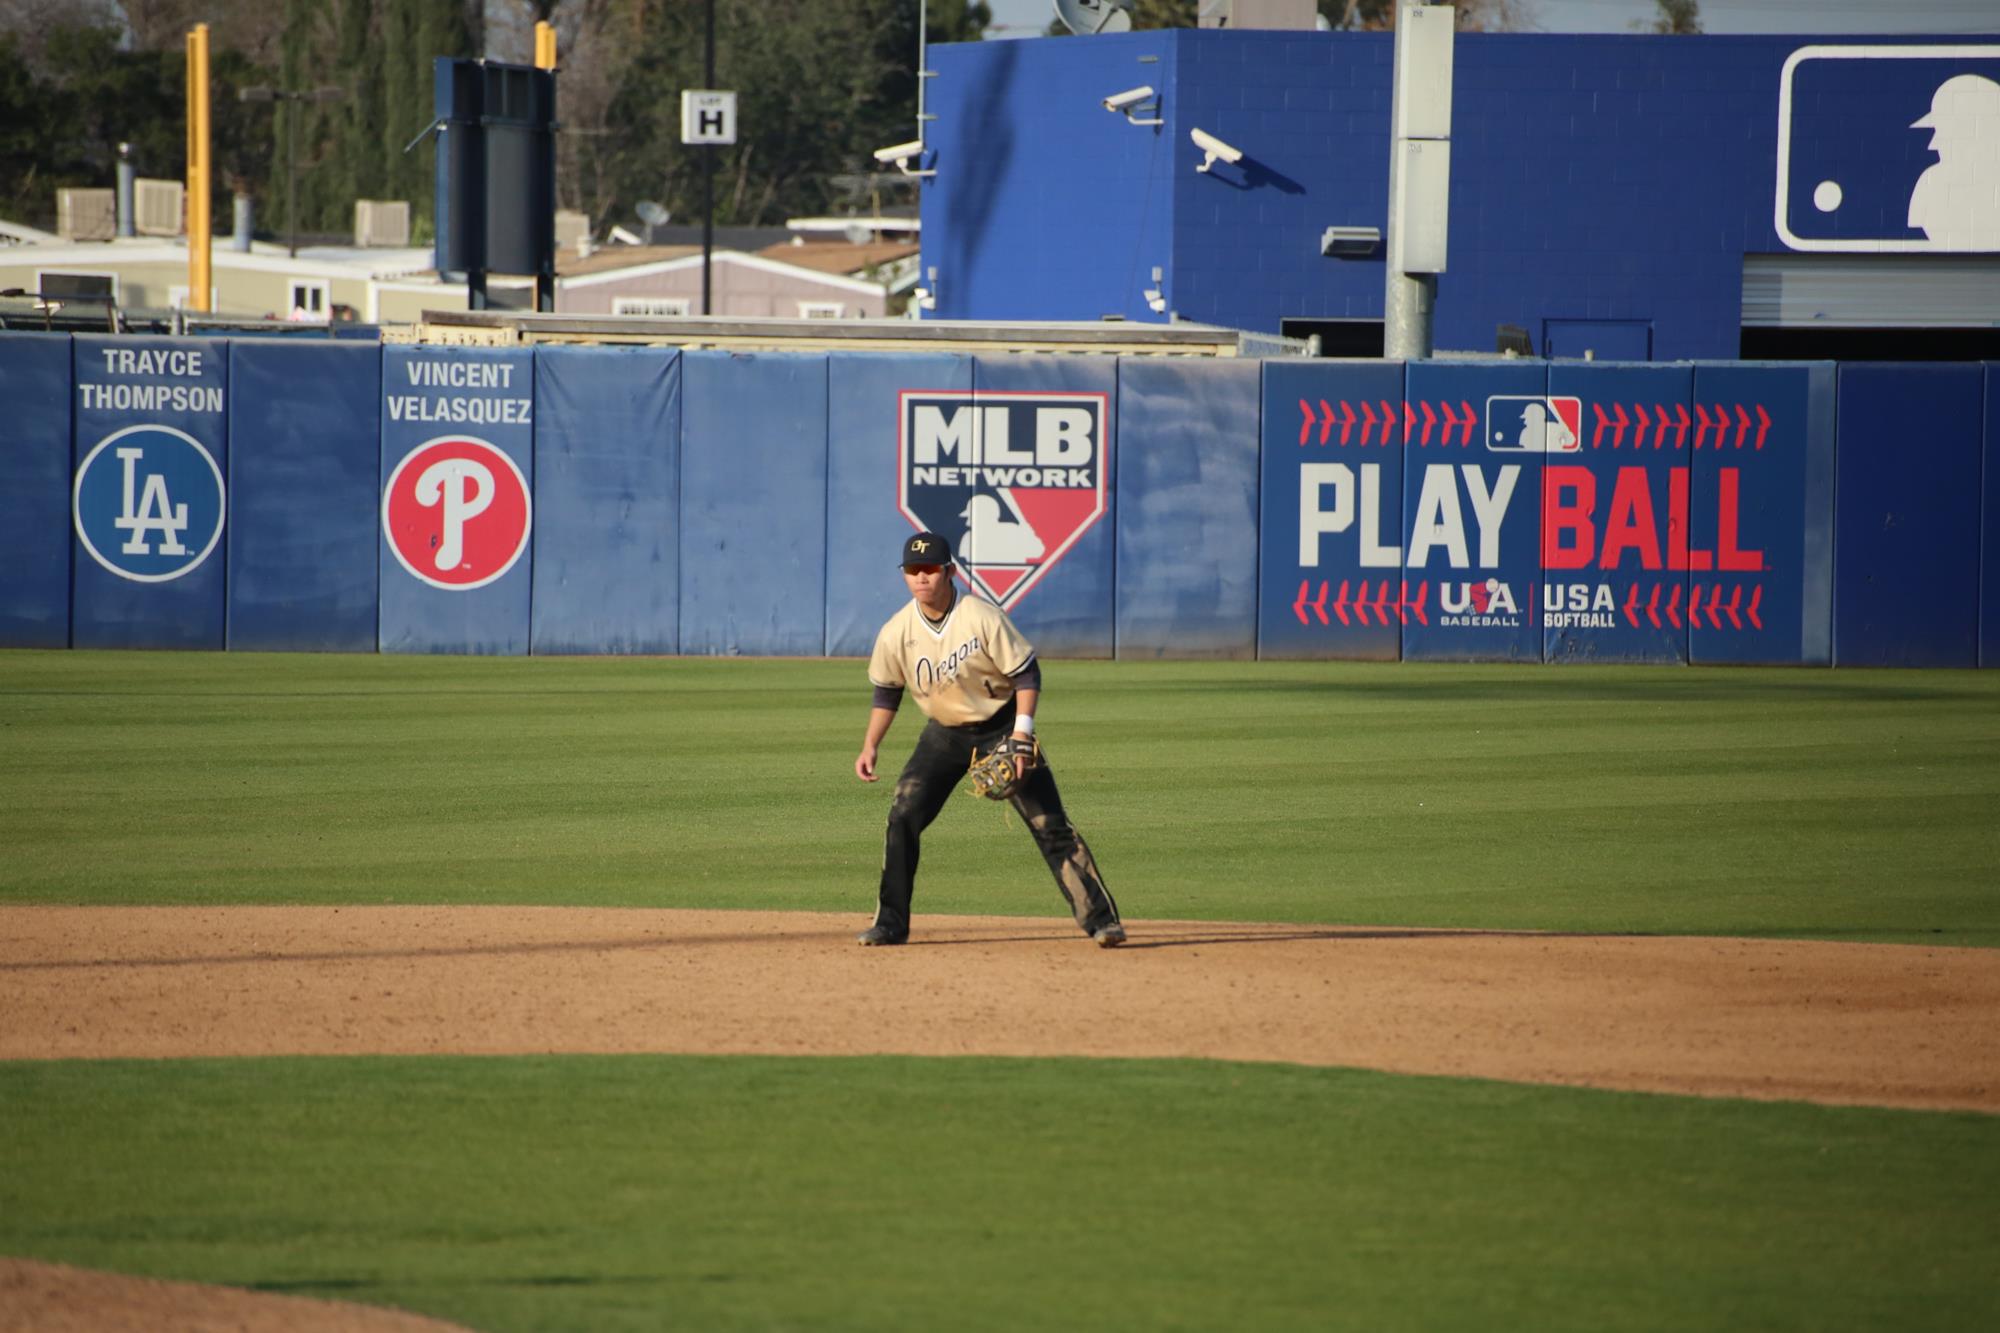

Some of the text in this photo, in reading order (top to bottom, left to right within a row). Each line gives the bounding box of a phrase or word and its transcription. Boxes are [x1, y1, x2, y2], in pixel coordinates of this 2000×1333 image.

[699, 110, 723, 136] H
[102, 348, 203, 376] TRAYCE
[407, 361, 515, 388] VINCENT
[79, 384, 224, 413] THOMPSON
[388, 396, 532, 425] VELASQUEZ
[913, 405, 1093, 467] MLB
[912, 466, 1093, 488] NETWORK
[114, 447, 189, 556] LA
[415, 458, 496, 571] P
[1298, 462, 1765, 572] PLAY BALL
[1439, 577, 1519, 615] USA
[1544, 583, 1616, 613] USA
[1439, 615, 1520, 628] BASEBALL
[1543, 611, 1616, 629] SOFTBALL
[916, 636, 981, 697] Oregon
[983, 679, 998, 699] 1
